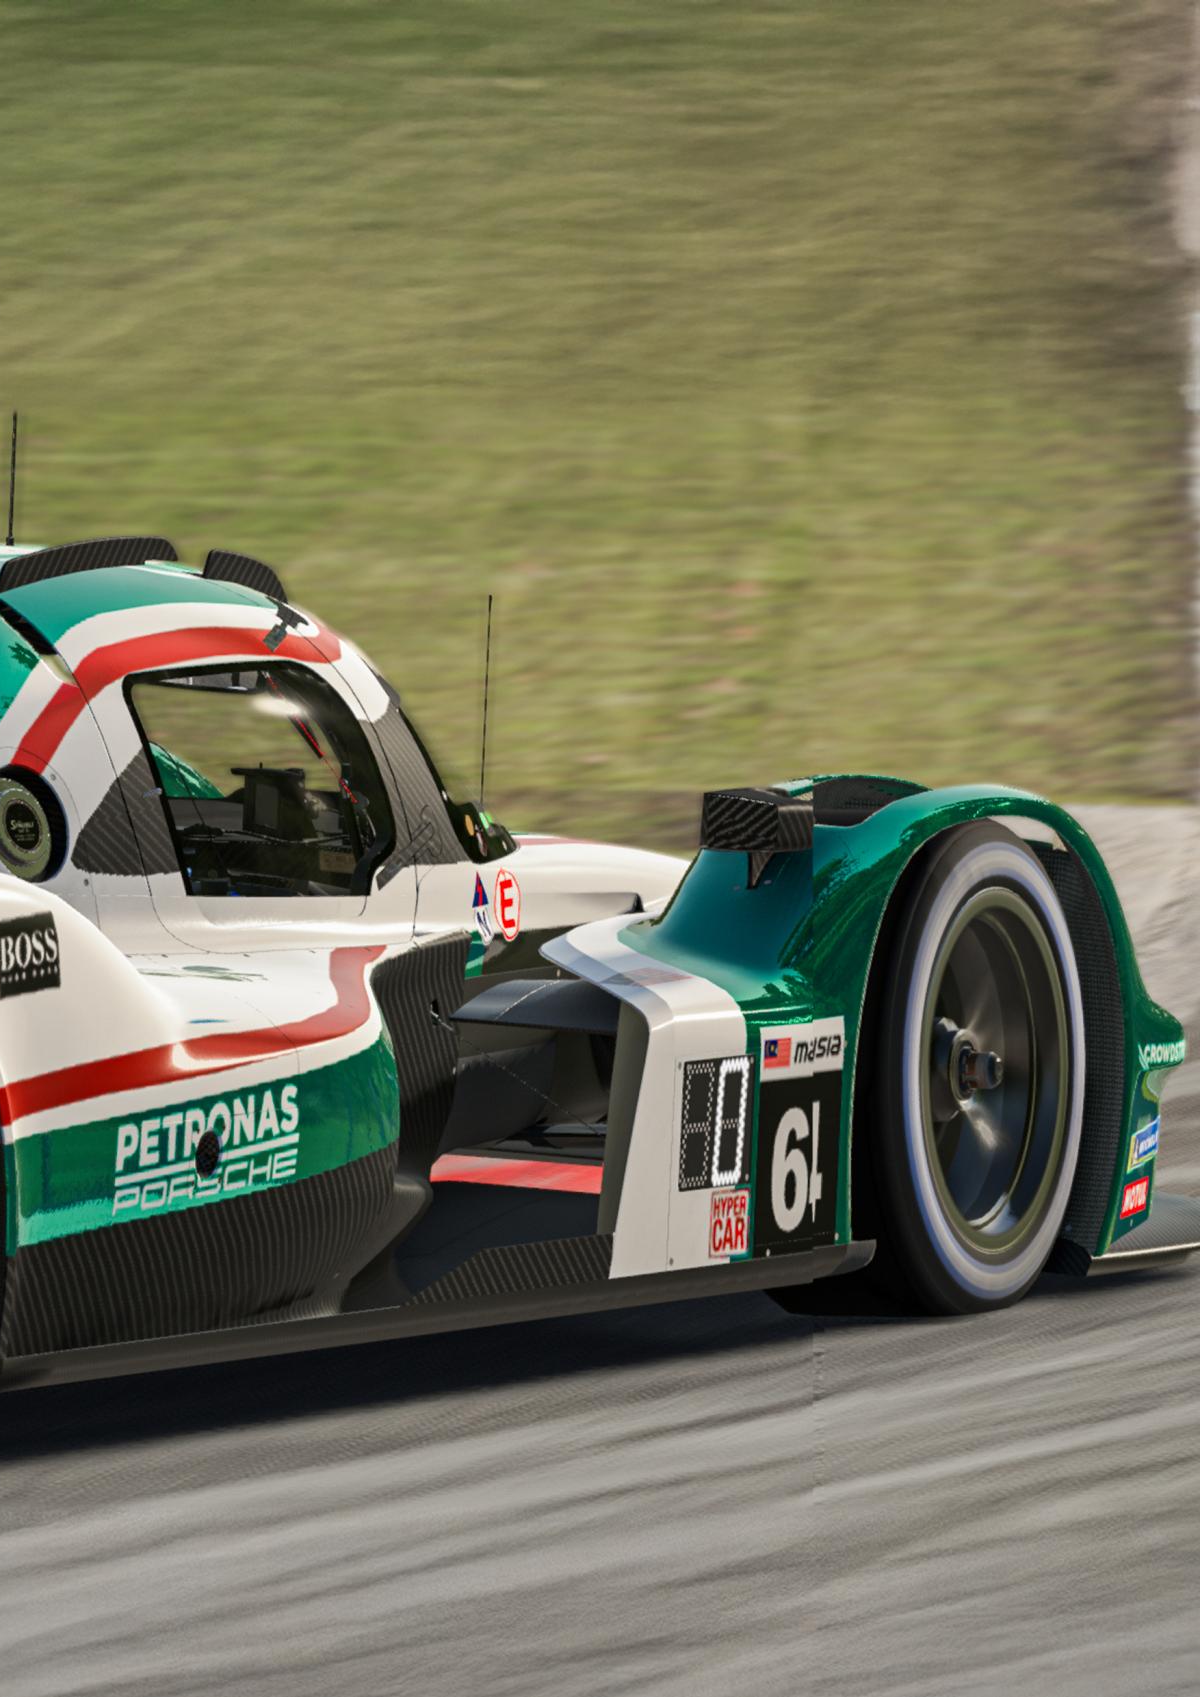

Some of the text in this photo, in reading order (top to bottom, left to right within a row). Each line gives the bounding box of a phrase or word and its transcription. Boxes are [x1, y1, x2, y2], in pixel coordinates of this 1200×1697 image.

[499, 879, 516, 929] E
[0, 928, 58, 972] BOSS
[115, 1084, 299, 1171] PETRONAS
[112, 1148, 298, 1217] PORSCHE
[713, 1196, 746, 1218] HYPER
[712, 1216, 746, 1252] CAR
